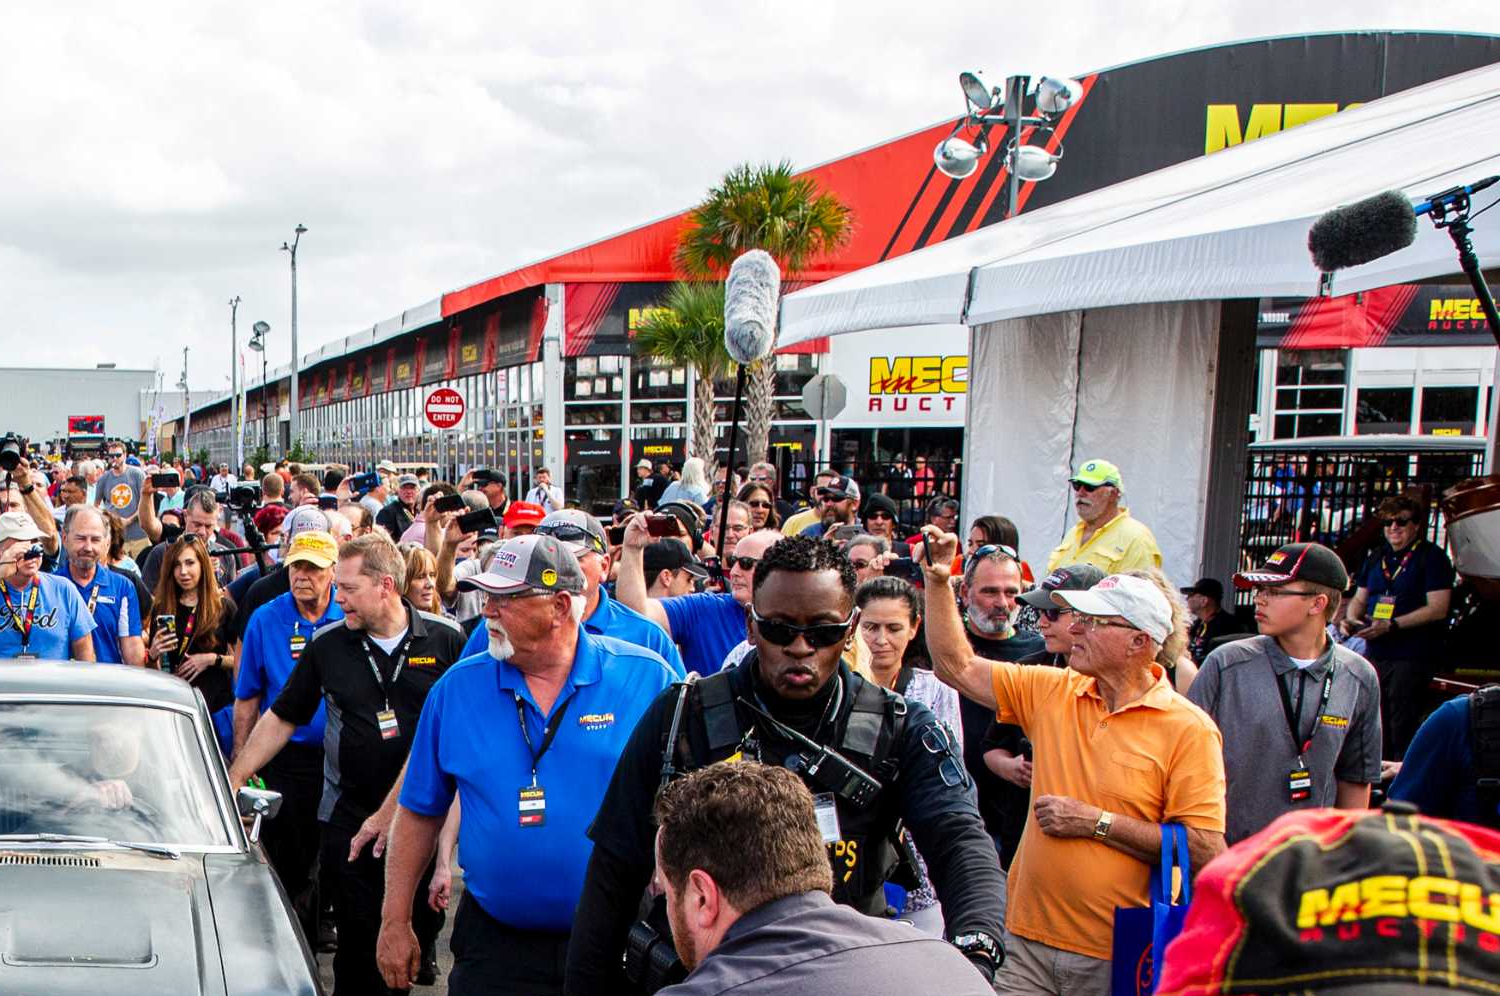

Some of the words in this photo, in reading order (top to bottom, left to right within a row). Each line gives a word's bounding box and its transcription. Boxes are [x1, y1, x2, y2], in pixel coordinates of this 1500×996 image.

[431, 396, 442, 404] DO
[445, 396, 460, 404] NOT
[868, 397, 956, 412] AUCT
[643, 445, 673, 456] MECUM
[408, 656, 437, 665] MECUM
[580, 713, 615, 724] MECUM
